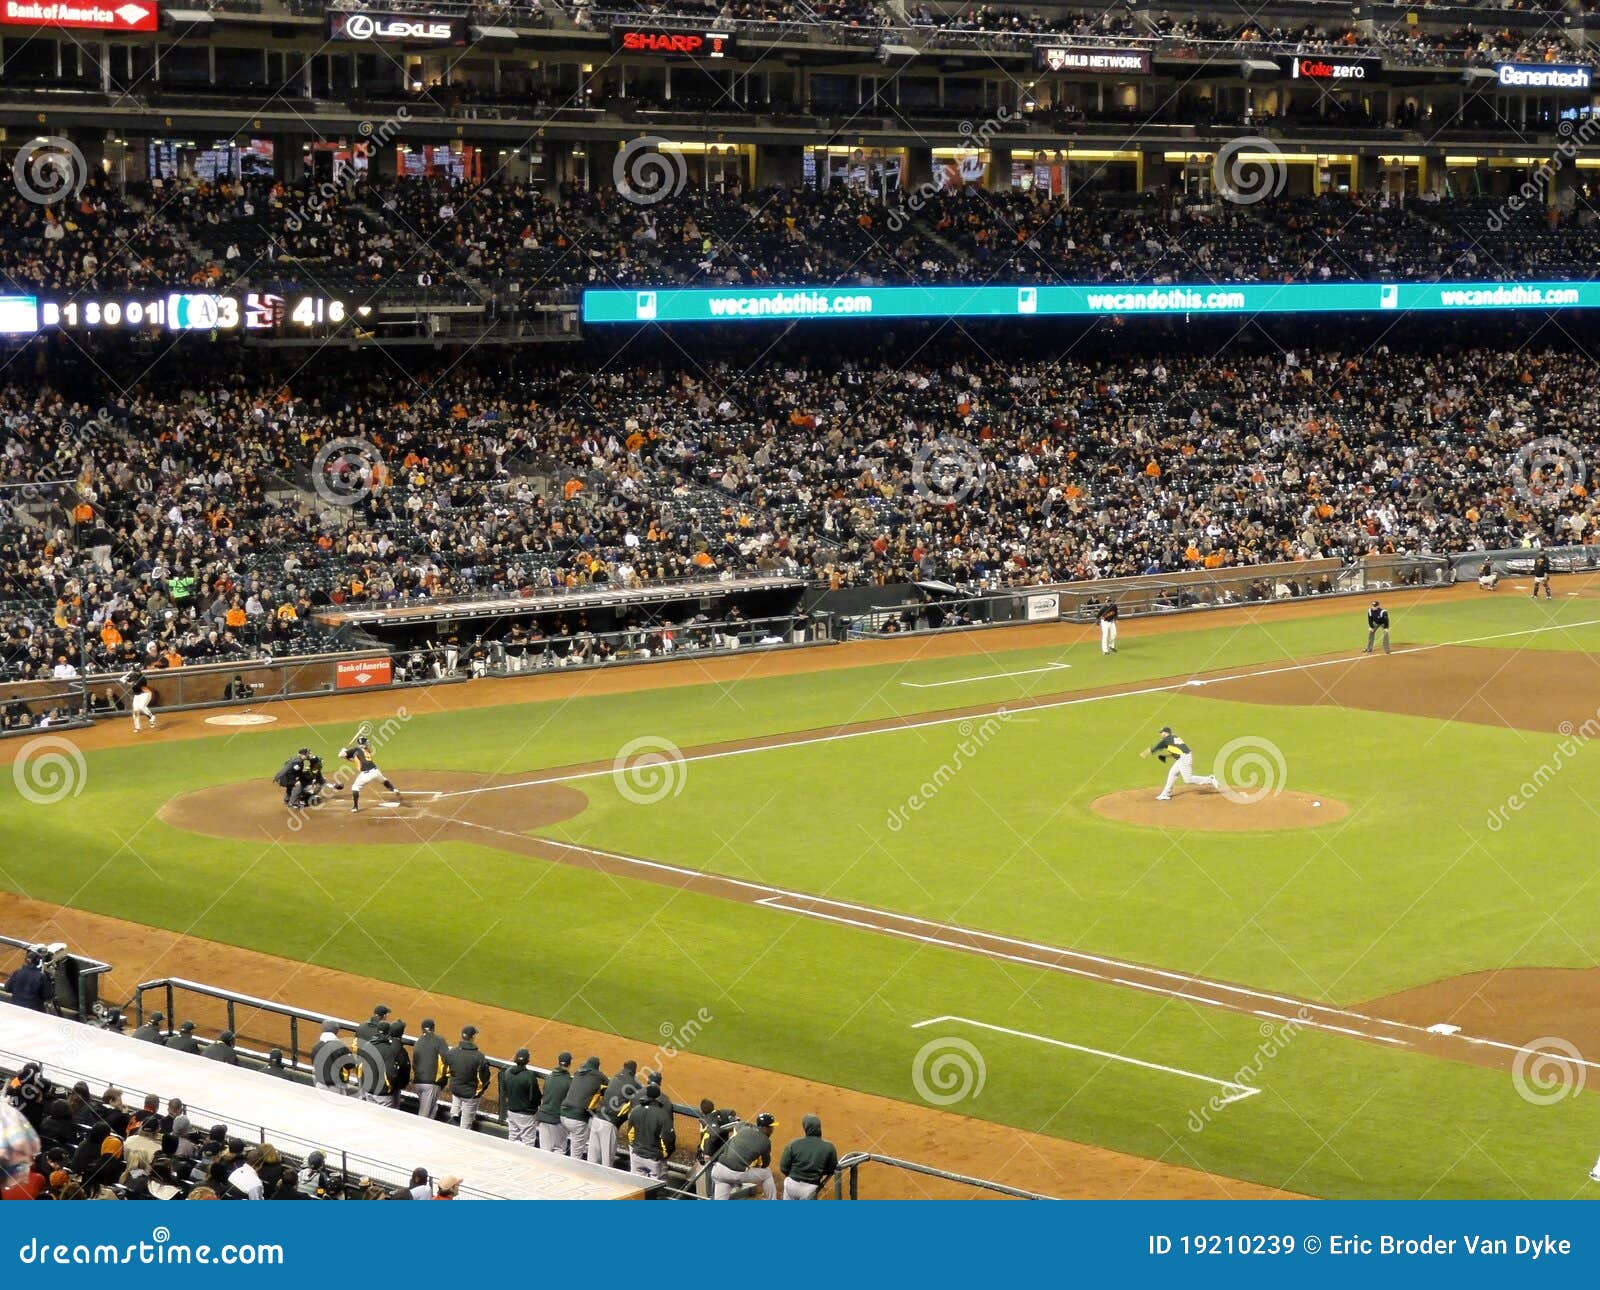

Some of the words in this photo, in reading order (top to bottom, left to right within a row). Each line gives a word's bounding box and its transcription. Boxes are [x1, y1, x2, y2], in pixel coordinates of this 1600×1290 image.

[7, 1, 43, 18] Bank
[43, 4, 58, 19] of
[58, 4, 114, 23] America
[375, 22, 451, 38] LEXUS
[623, 33, 703, 52] SHARP
[1065, 54, 1088, 66] MLB
[1089, 55, 1142, 69] NETWORK
[1300, 60, 1333, 77] Coke
[1333, 65, 1363, 78] zero
[1500, 65, 1589, 87] Genentech
[708, 292, 873, 316] wecandothis.com
[1086, 288, 1245, 310] wecandothis.com
[1440, 286, 1580, 306] wecandothis.com
[337, 664, 354, 673] Bank
[355, 662, 362, 672] of
[362, 660, 390, 671] America
